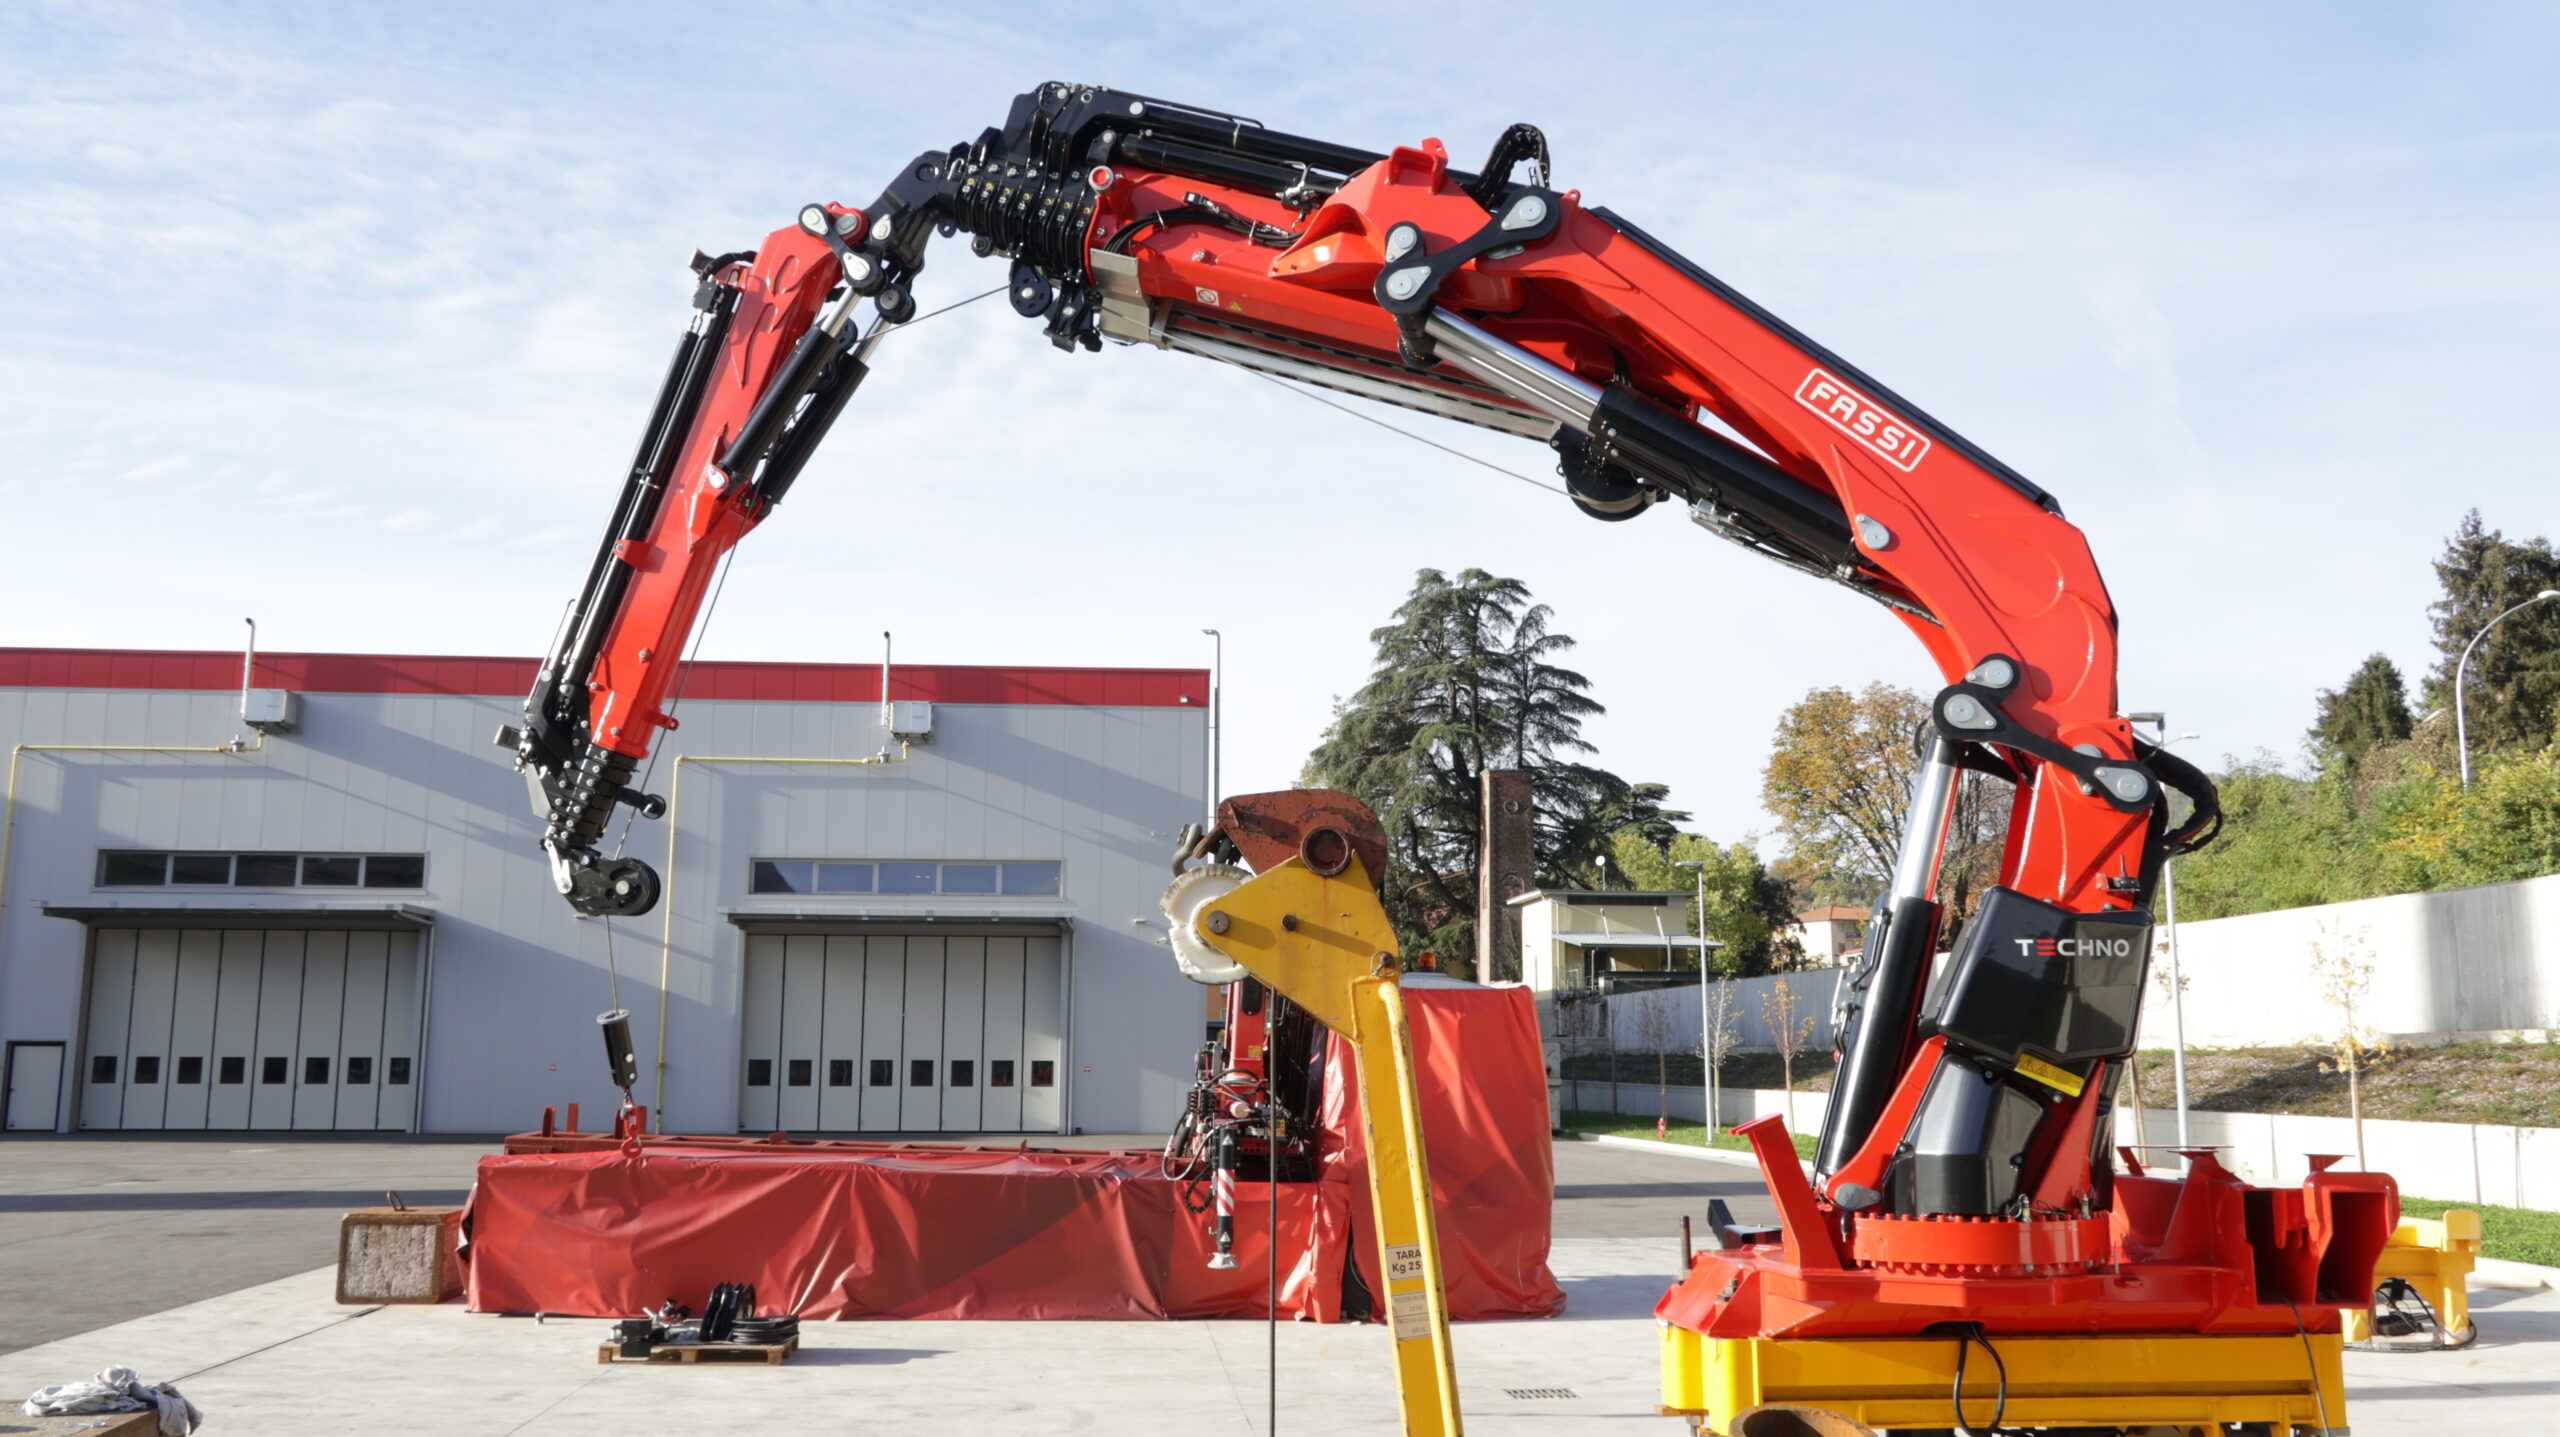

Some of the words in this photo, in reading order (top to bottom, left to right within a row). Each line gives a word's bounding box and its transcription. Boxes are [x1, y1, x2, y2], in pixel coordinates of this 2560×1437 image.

[1809, 381, 1917, 460] FASSI
[2014, 938, 2130, 957] TECHNO
[1396, 1249, 1422, 1260] TARA
[1392, 1262, 1406, 1274] Kg
